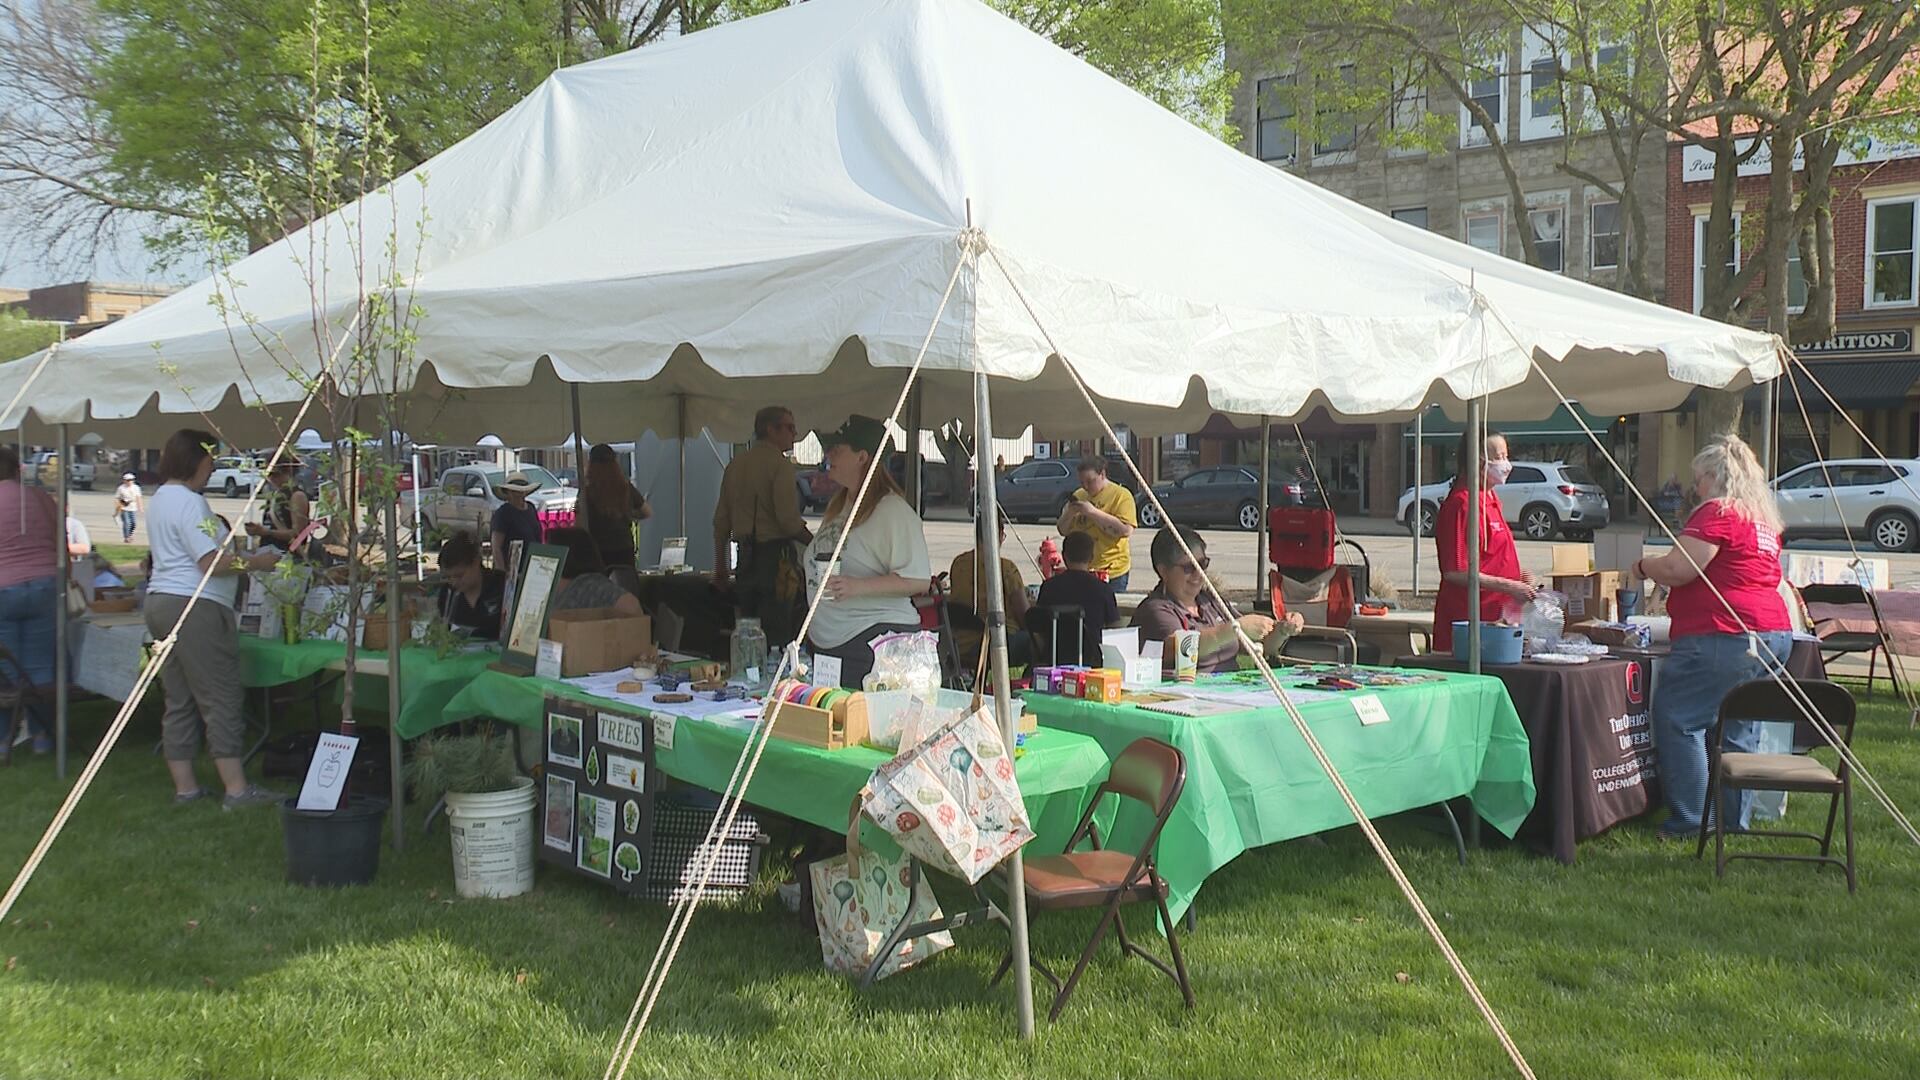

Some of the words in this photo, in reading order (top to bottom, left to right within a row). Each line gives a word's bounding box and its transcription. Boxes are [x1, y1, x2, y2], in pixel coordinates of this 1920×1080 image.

[600, 718, 640, 746] TREES
[1592, 763, 1626, 780] COLLEGE
[1598, 781, 1615, 794] AND
